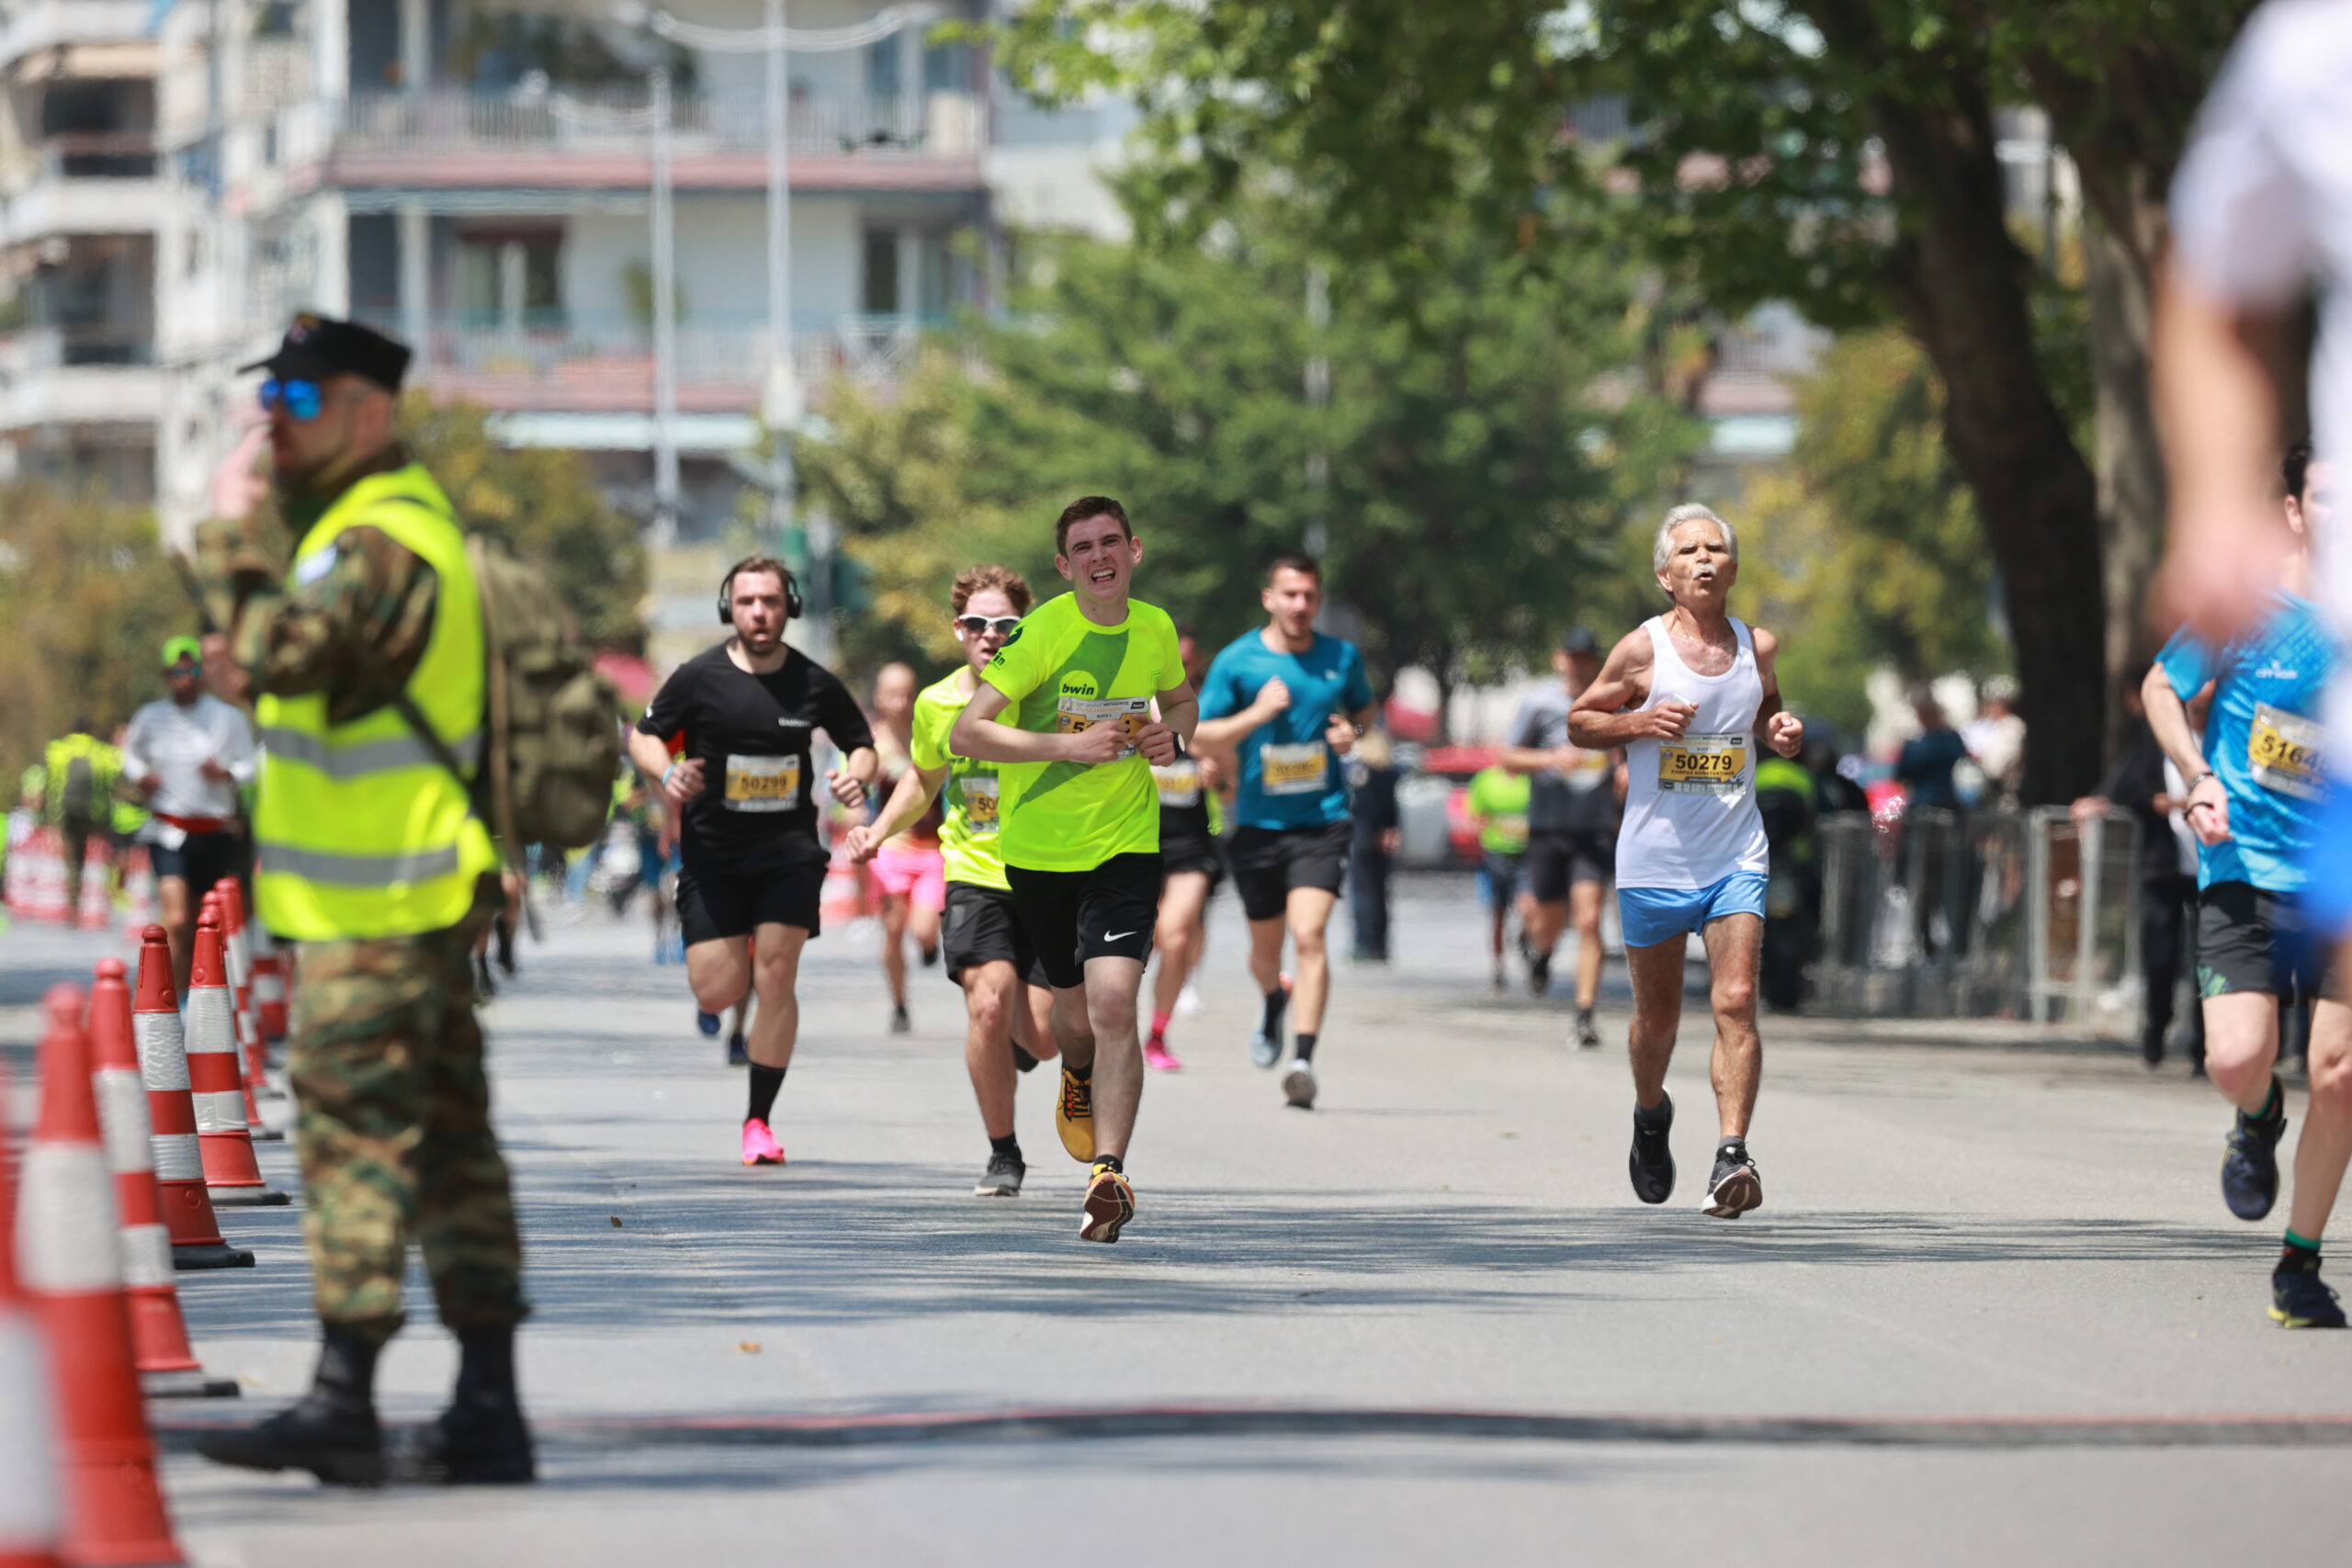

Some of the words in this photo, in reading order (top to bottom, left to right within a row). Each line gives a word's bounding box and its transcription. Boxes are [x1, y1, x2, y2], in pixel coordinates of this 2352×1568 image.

[1061, 683, 1094, 695] bwin
[1676, 755, 1732, 770] 50279
[978, 797, 999, 810] 50
